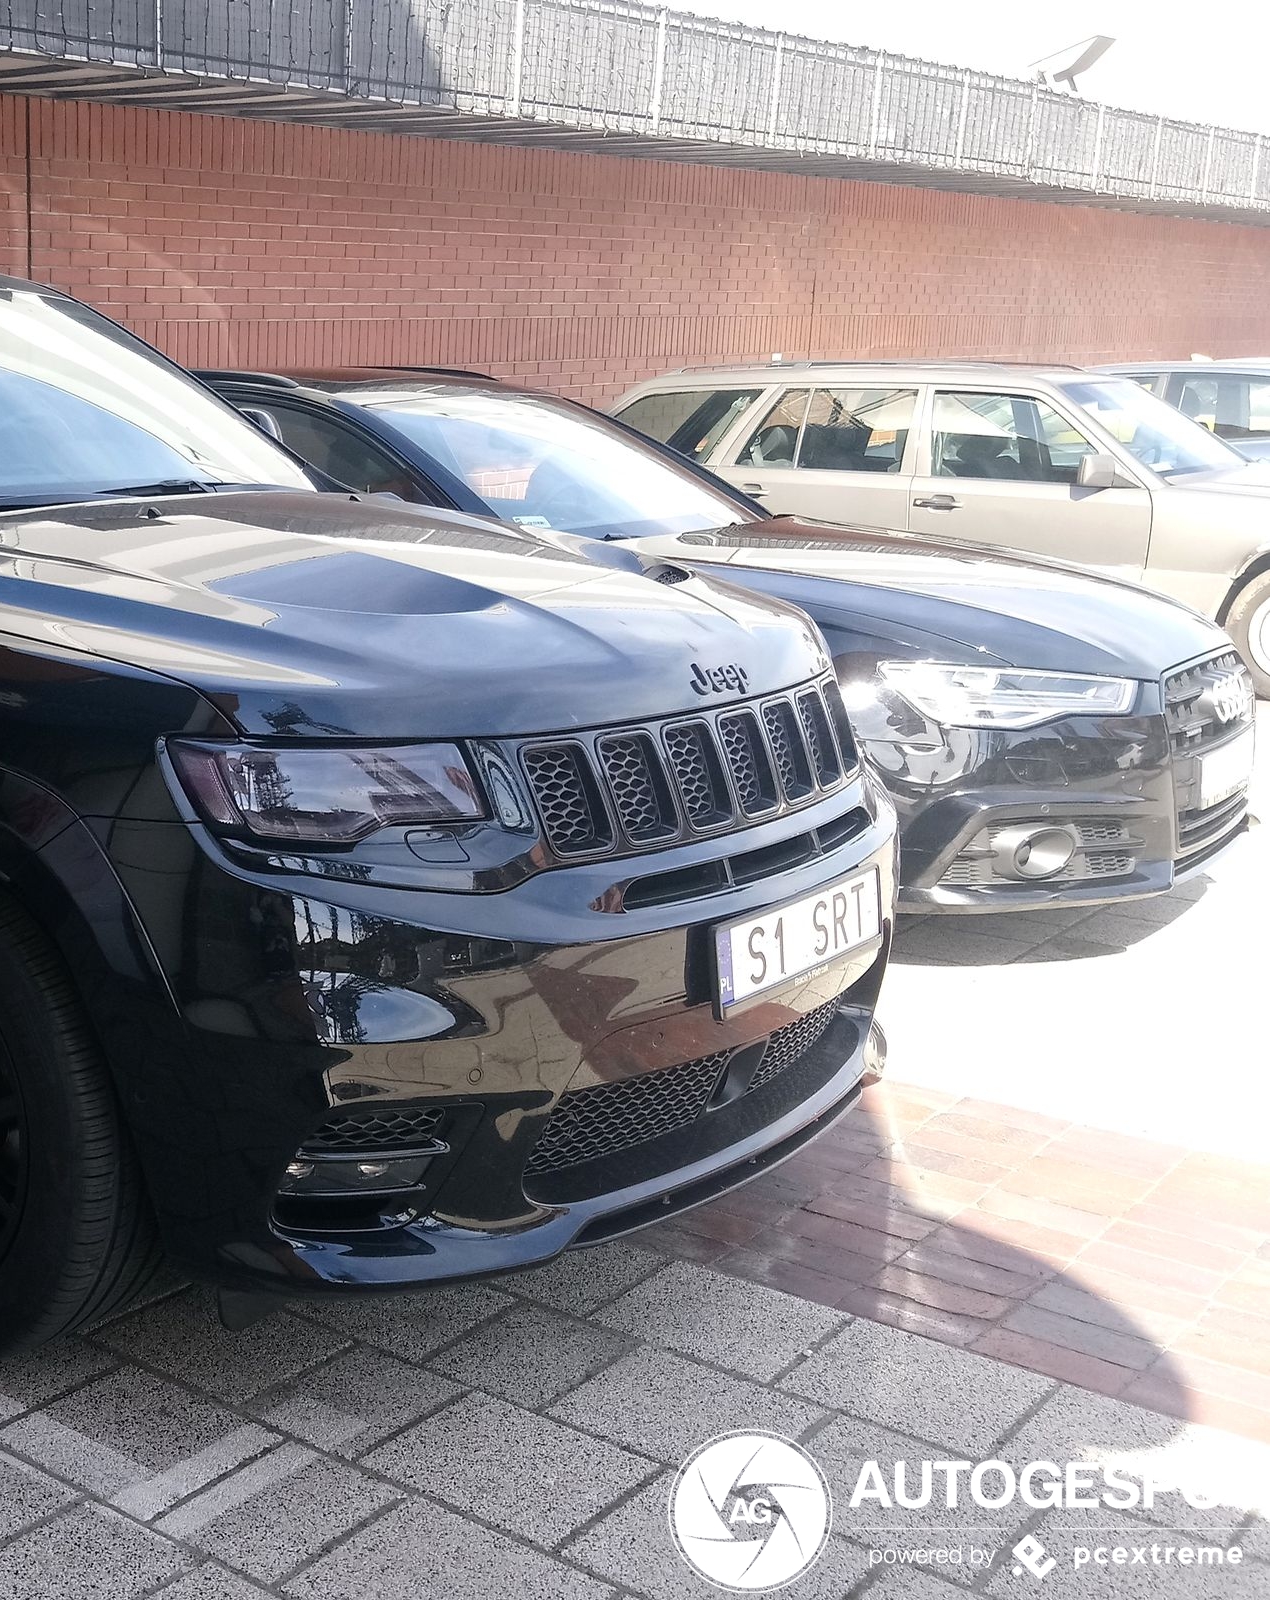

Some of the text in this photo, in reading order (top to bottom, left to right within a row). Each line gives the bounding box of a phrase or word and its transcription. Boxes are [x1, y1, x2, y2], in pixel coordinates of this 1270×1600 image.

[689, 662, 750, 696] Jeep
[748, 881, 866, 985] S1 SRT
[720, 976, 733, 995] PL
